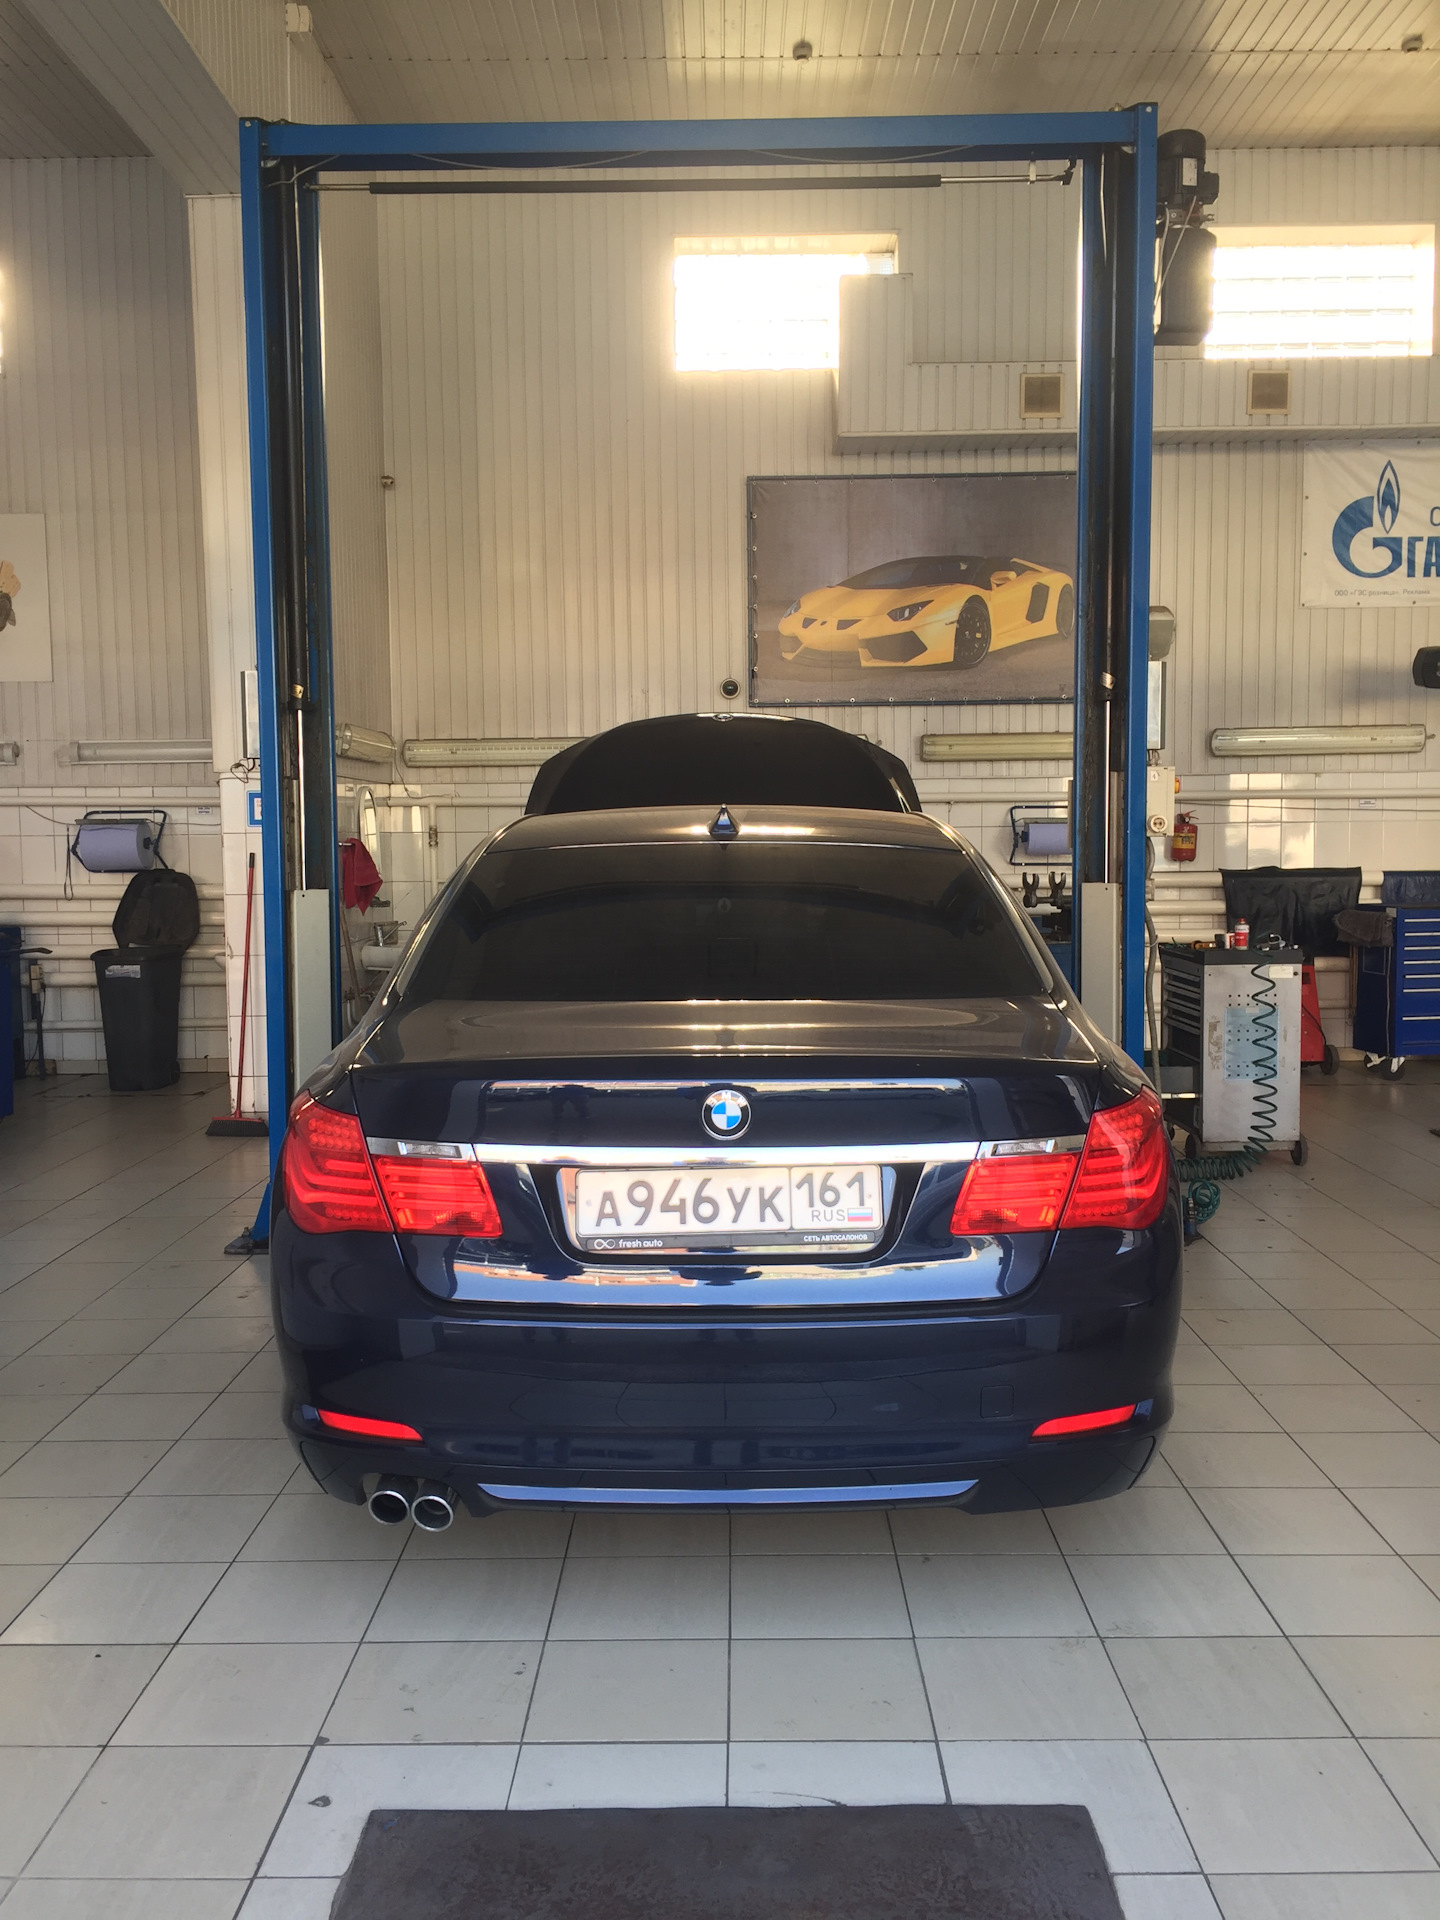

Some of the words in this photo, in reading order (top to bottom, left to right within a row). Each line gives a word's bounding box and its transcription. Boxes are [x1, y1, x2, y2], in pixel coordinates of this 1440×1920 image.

[706, 1091, 748, 1108] BMW
[595, 1178, 784, 1227] А946УК
[796, 1172, 867, 1208] 161
[811, 1209, 846, 1222] RUS
[821, 1233, 868, 1241] АВТОСАЛОНОВ
[618, 1239, 642, 1249] fresh
[643, 1239, 664, 1248] auto
